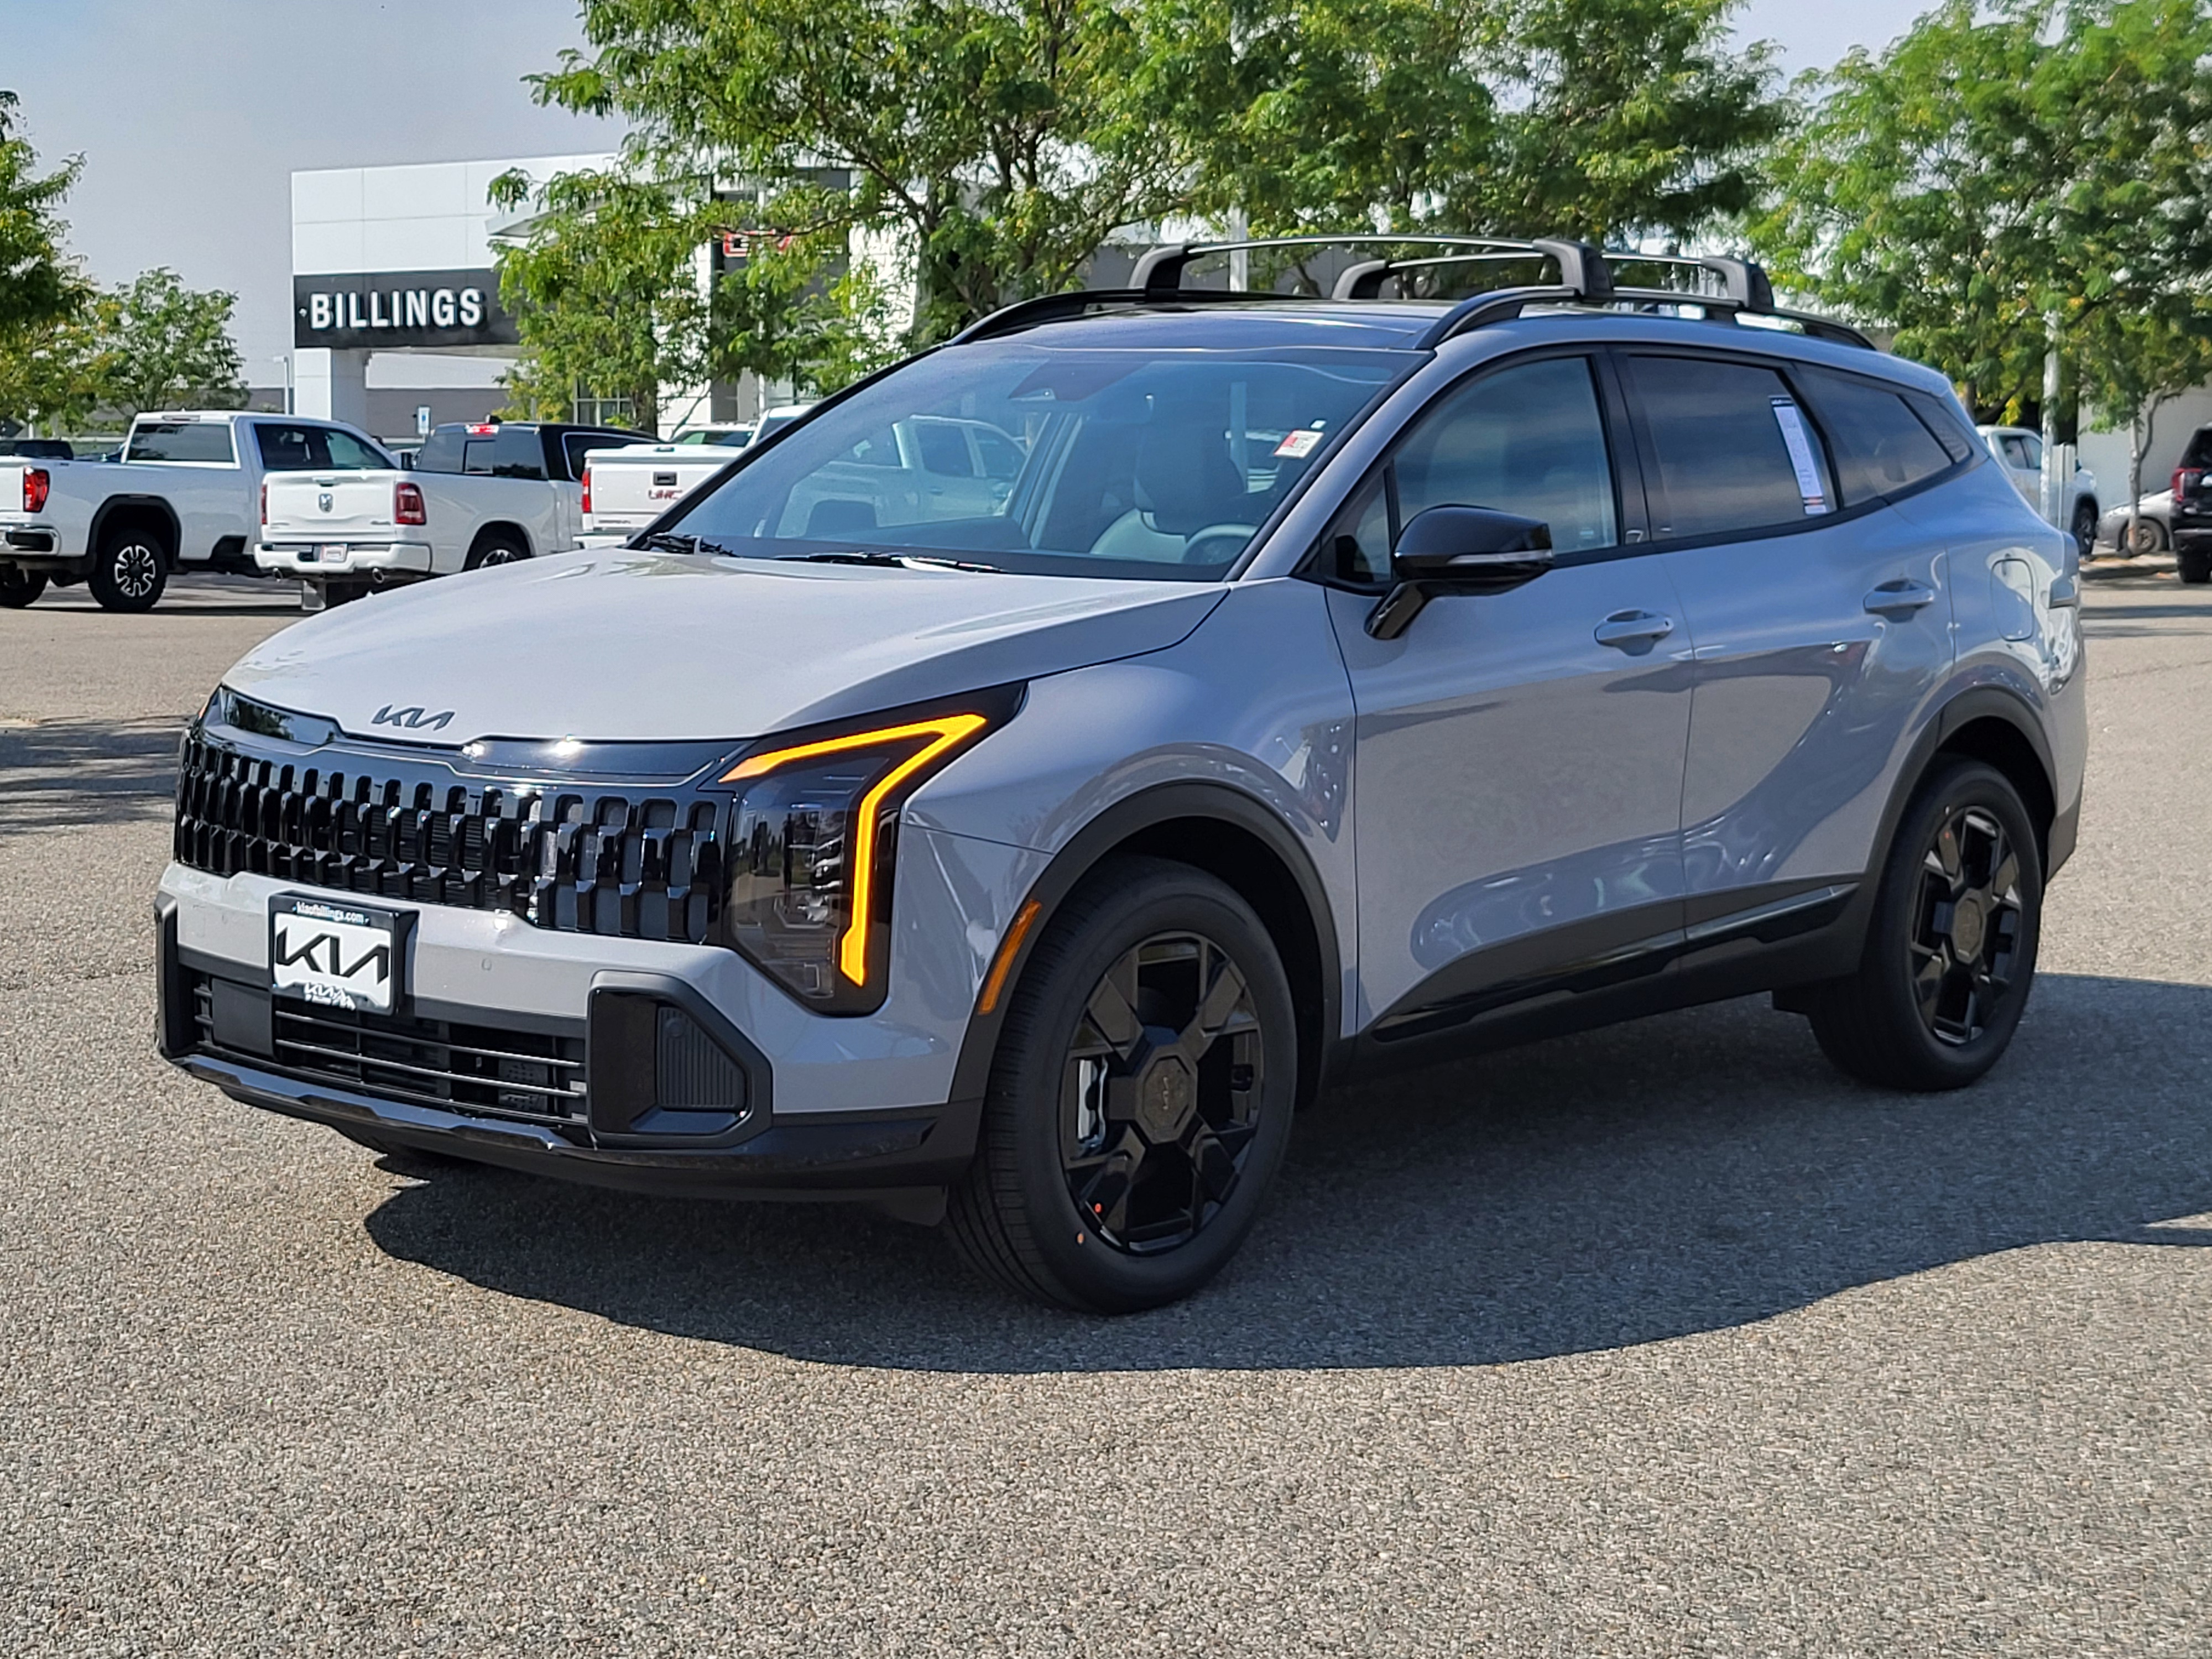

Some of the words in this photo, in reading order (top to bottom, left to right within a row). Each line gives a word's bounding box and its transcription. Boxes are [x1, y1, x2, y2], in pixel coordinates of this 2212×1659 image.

[311, 288, 481, 328] BILLINGS
[371, 704, 455, 731] KIA
[276, 925, 390, 985] KIA
